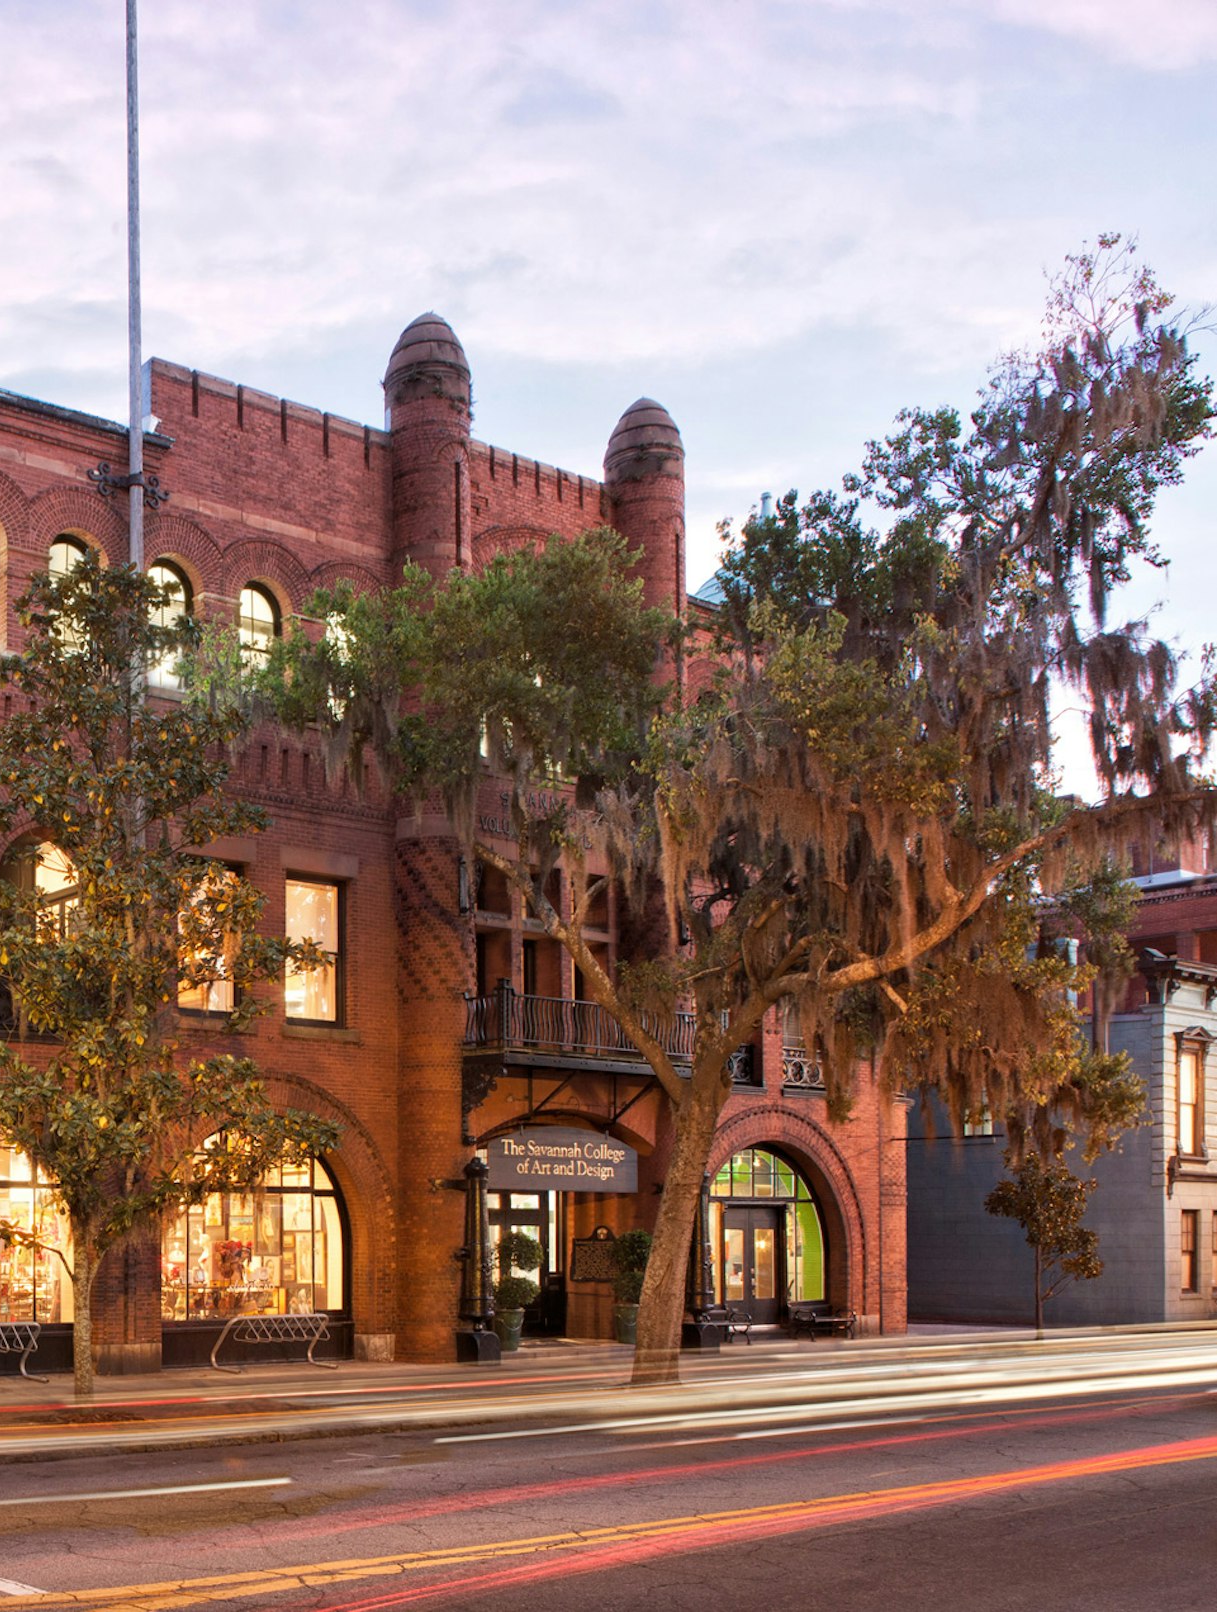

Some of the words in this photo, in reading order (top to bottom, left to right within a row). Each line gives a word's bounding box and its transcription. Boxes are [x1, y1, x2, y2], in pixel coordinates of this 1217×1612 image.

[501, 1138, 525, 1156] The
[527, 1140, 582, 1158] Savannah
[584, 1143, 625, 1164] College
[516, 1158, 530, 1175] of
[531, 1160, 551, 1175] Art
[553, 1160, 575, 1176] and
[577, 1160, 615, 1181] Design
